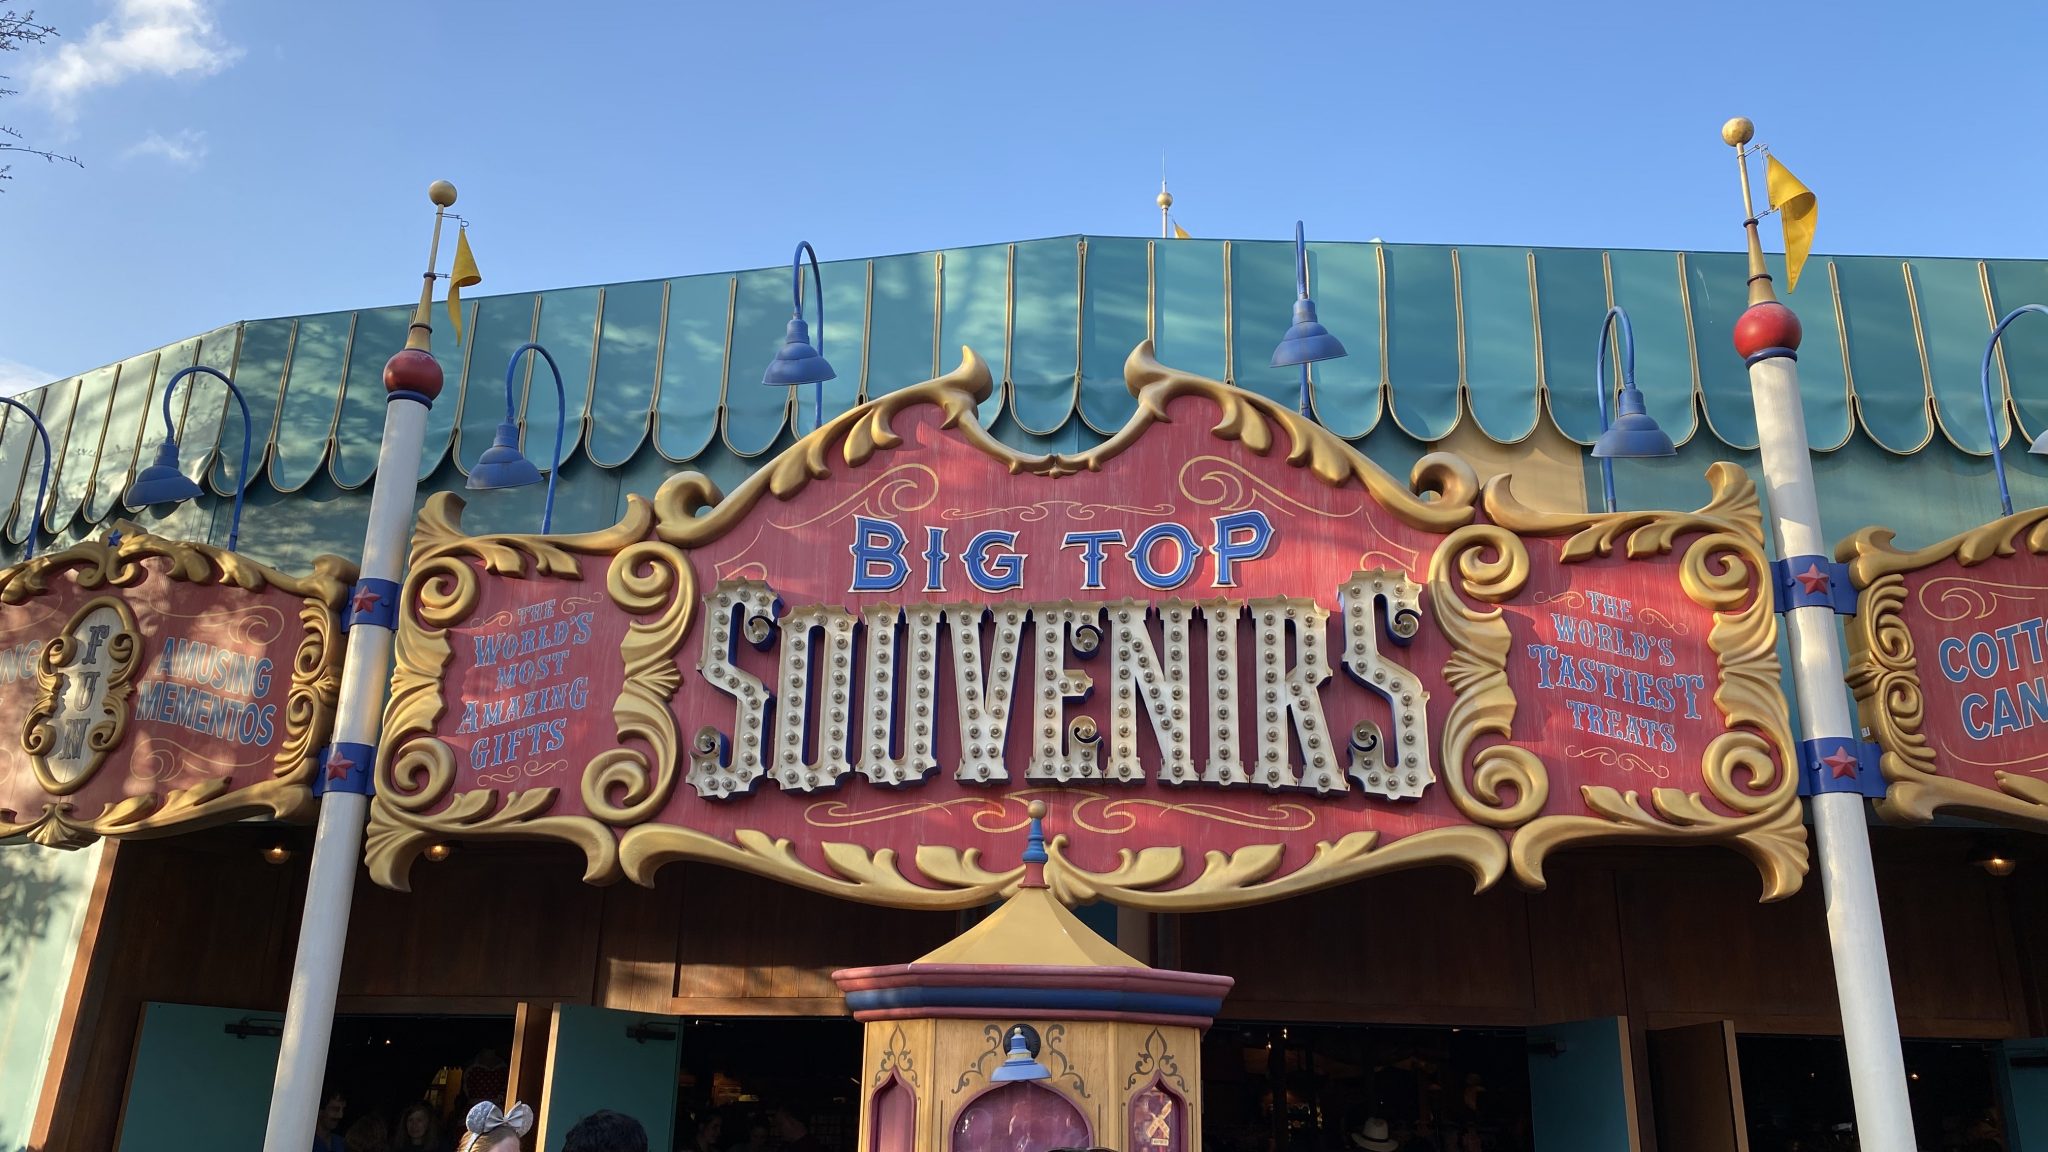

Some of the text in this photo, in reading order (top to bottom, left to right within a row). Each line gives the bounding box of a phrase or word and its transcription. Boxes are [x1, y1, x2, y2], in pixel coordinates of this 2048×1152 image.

[848, 510, 1275, 593] BIG TOP
[518, 599, 556, 626] THE
[1585, 590, 1633, 622] THE
[154, 636, 274, 699] AMUSING
[474, 612, 594, 667] WORLD'S
[1551, 613, 1676, 667] WORLD'S
[1938, 617, 2048, 683] COTT
[58, 624, 112, 760] FUN
[494, 650, 570, 692] MOST
[685, 566, 1436, 801] SOUVENIRS
[1527, 644, 1704, 720] TASTIEST
[135, 680, 278, 747] MEMENTOS
[456, 677, 589, 734] AMAZING
[1566, 699, 1677, 753] TREATS
[470, 718, 567, 770] GIFTS
